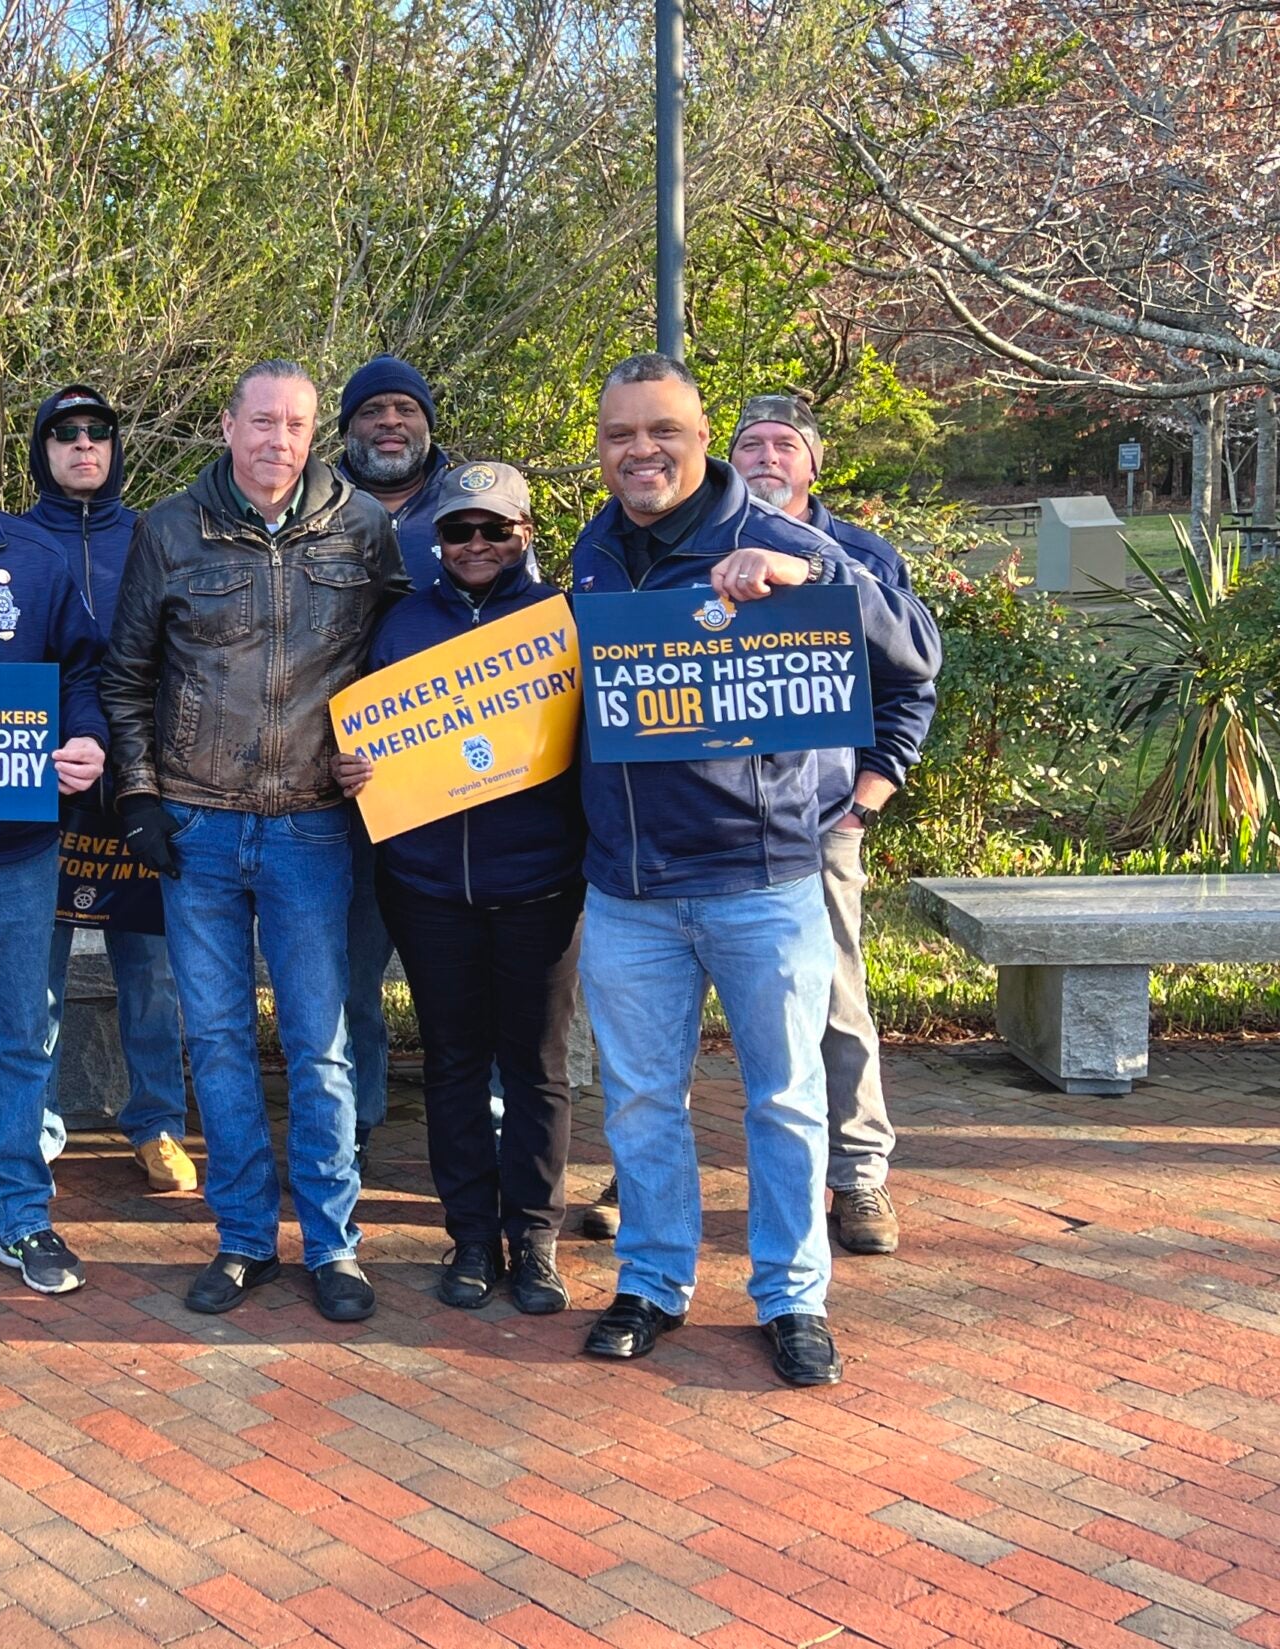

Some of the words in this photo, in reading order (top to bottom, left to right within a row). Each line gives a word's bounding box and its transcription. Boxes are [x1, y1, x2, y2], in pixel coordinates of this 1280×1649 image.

[592, 643, 656, 661] DON'T
[663, 638, 734, 658] ERASE
[739, 631, 852, 651] WORKERS
[341, 676, 451, 737] WORKER
[454, 628, 568, 690] HISTORY
[594, 661, 703, 687] LABOR
[712, 650, 854, 682] HISTORY
[354, 704, 475, 763] AMERICAN
[478, 667, 578, 720] HISTORY
[597, 690, 630, 727] IS
[635, 687, 704, 727] OUR
[711, 674, 856, 723] HISTORY
[448, 781, 482, 798] Virginia
[482, 765, 529, 785] Teamsters
[58, 856, 110, 880] TORY
[112, 863, 134, 880] IN
